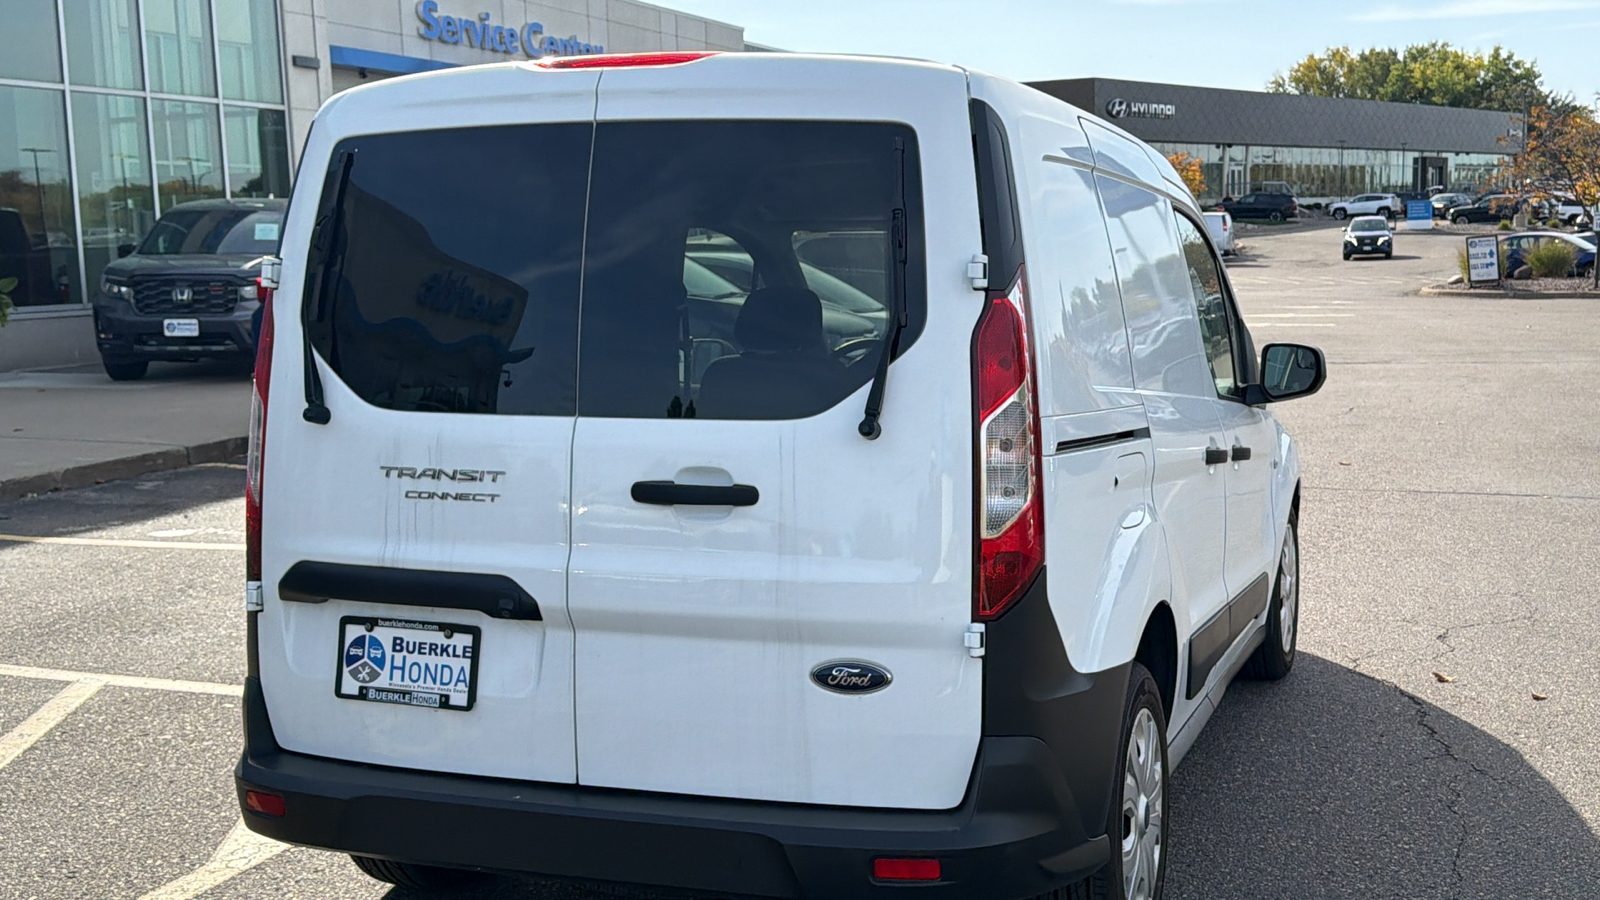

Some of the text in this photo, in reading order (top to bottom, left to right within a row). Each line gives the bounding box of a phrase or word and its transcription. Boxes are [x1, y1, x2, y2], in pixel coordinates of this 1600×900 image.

[417, 0, 519, 53] Service
[1131, 102, 1175, 115] HYUNDAI
[380, 465, 507, 483] TRANSIT
[405, 490, 501, 503] CONNECT
[378, 619, 439, 630] buerklehonda.com
[392, 636, 473, 659] BUERKLE
[389, 654, 469, 688] HONDA
[827, 667, 872, 686] Ford
[368, 689, 439, 707] BUERKLE HONDA
